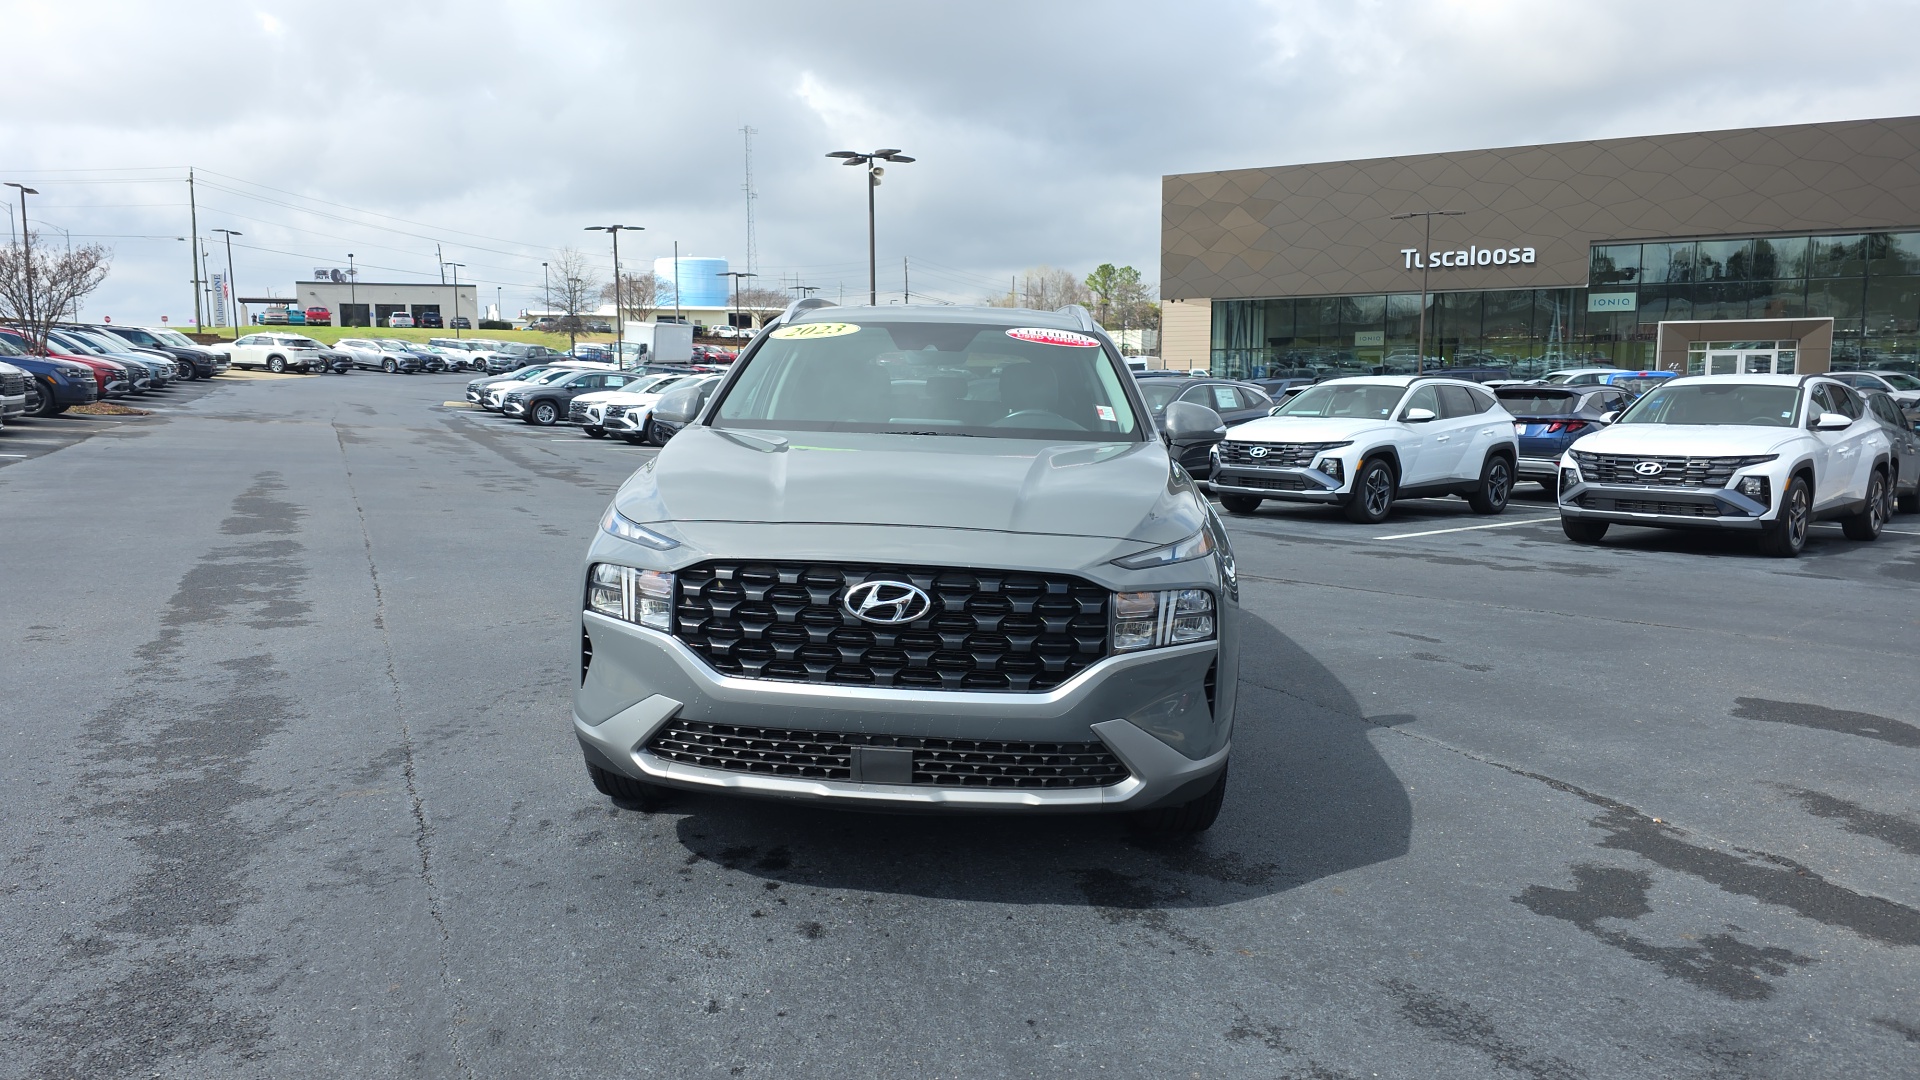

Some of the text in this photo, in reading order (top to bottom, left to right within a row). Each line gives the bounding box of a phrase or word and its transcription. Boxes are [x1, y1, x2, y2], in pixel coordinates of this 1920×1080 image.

[1400, 245, 1536, 269] Tuscaloosa
[1593, 298, 1630, 306] IONIQ
[785, 325, 847, 337] 2023
[1046, 336, 1090, 346] VEHICLE
